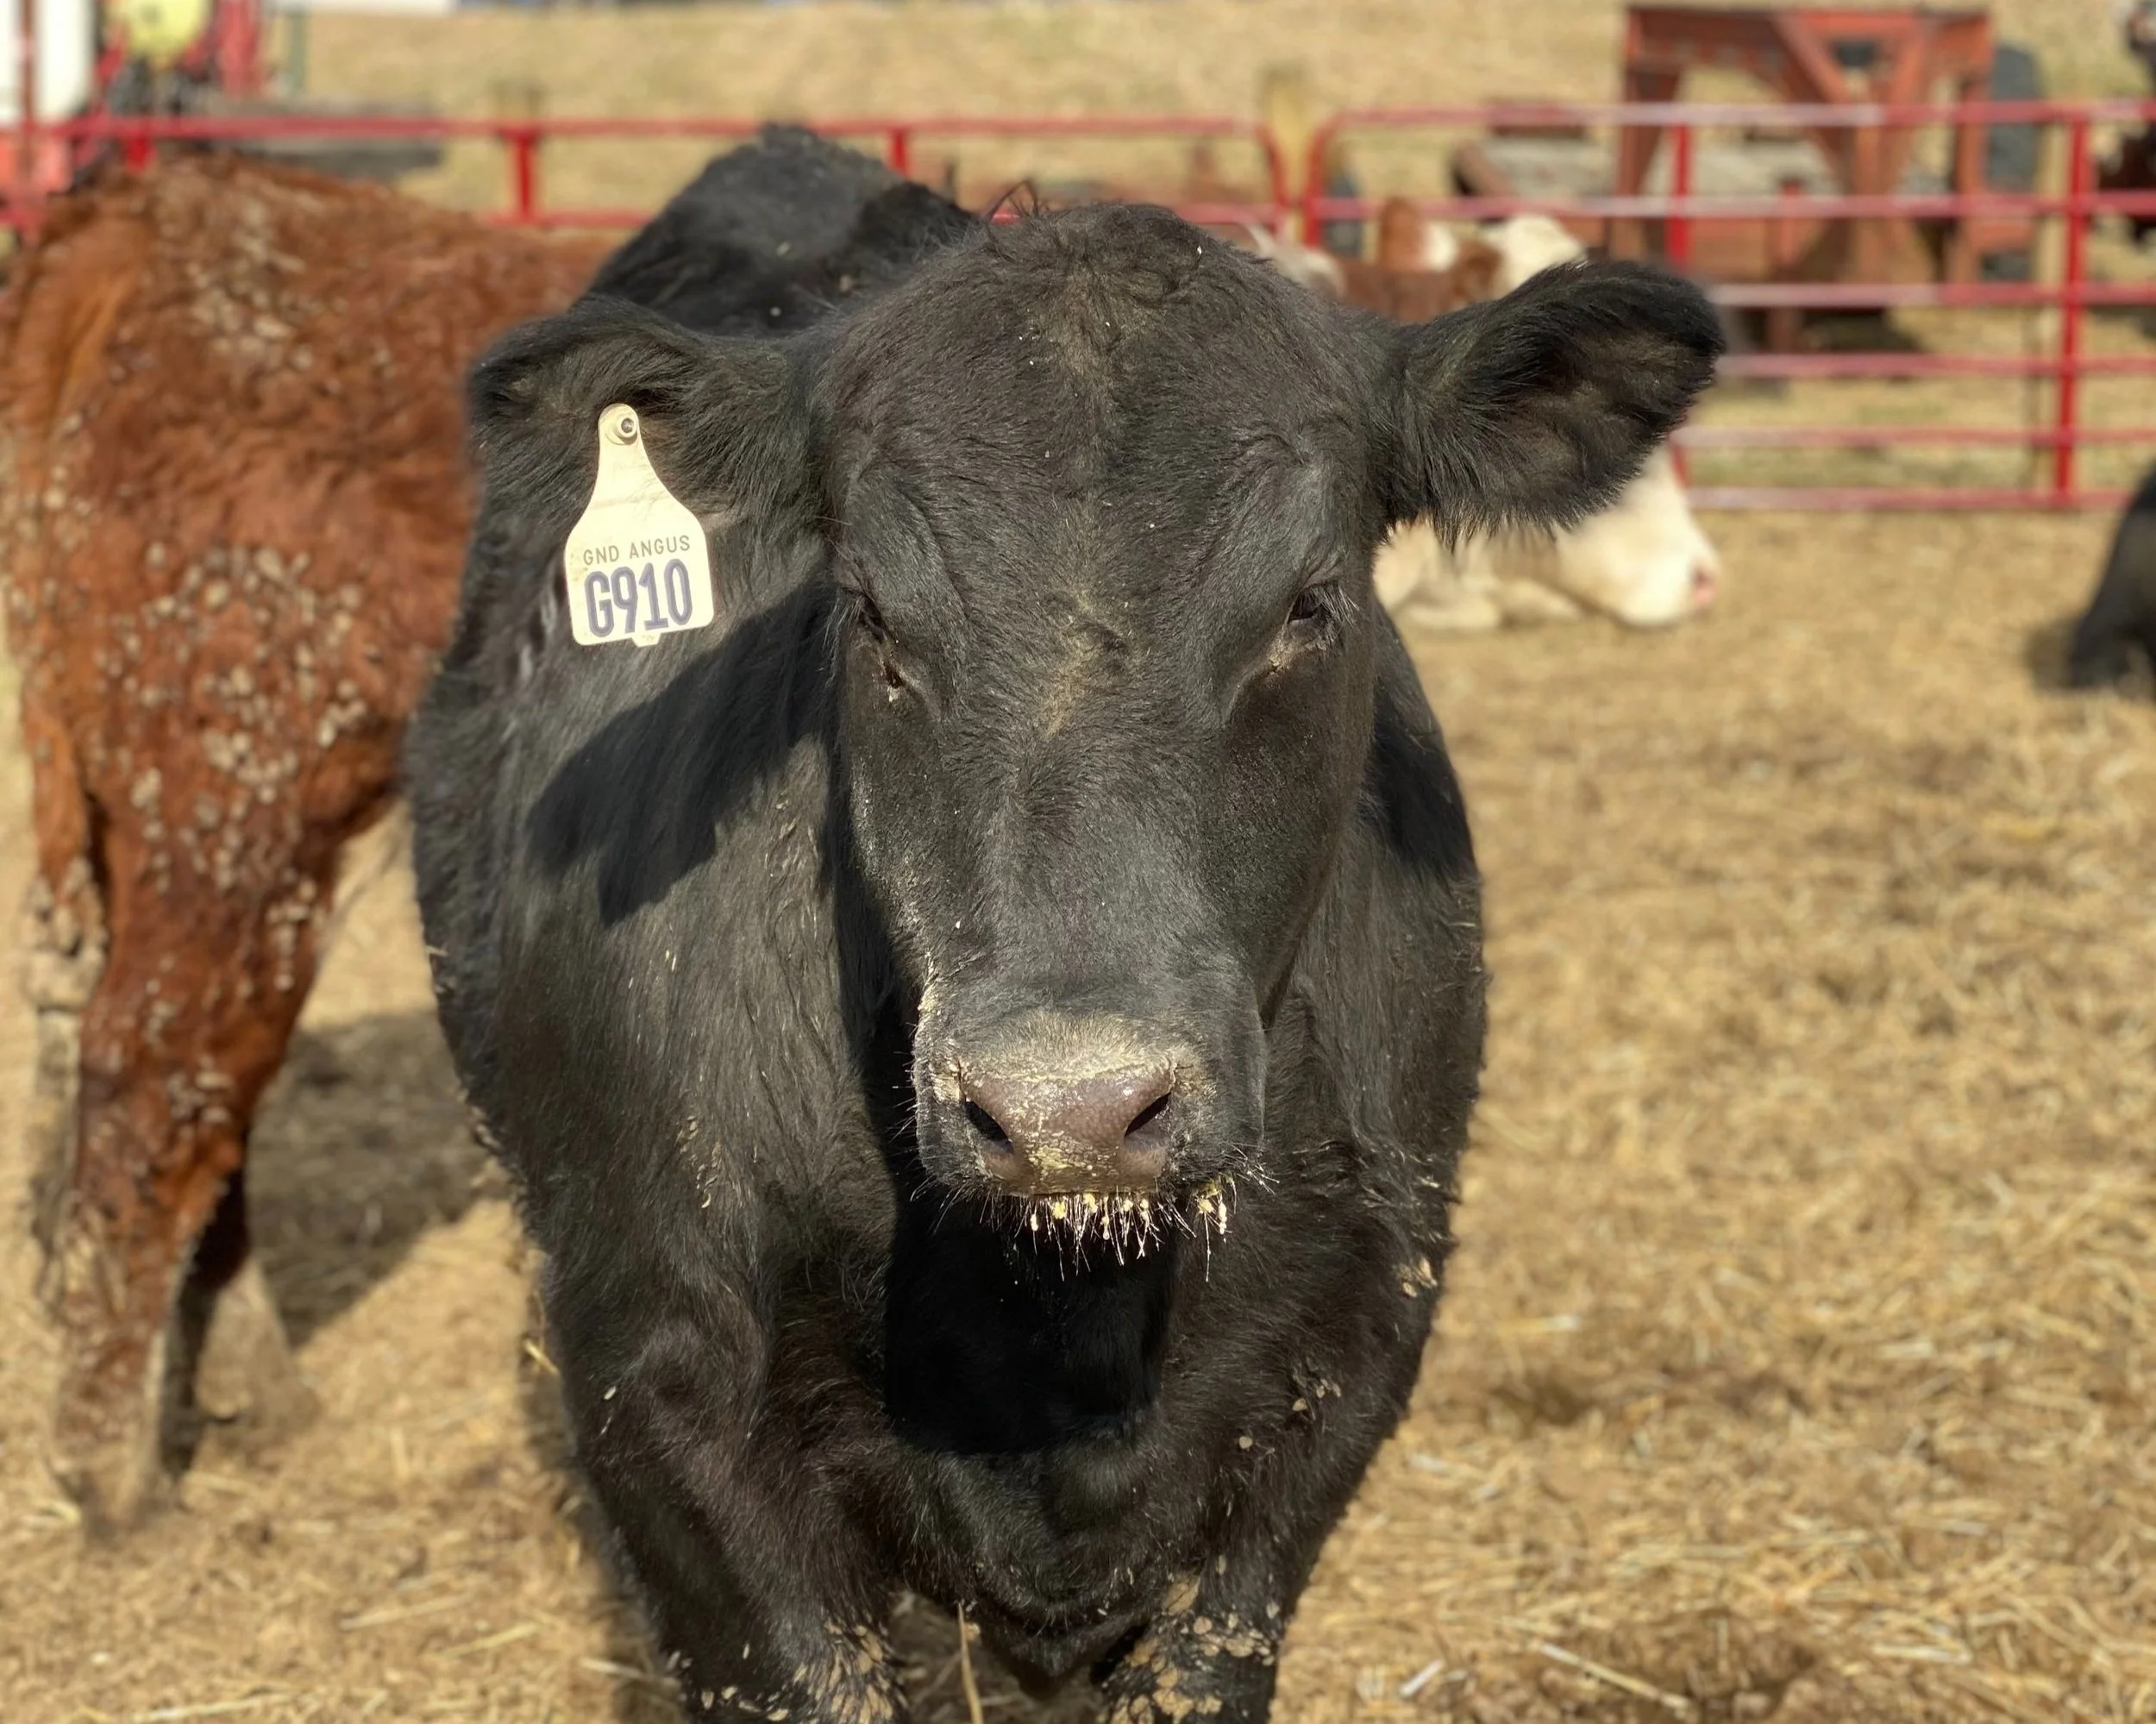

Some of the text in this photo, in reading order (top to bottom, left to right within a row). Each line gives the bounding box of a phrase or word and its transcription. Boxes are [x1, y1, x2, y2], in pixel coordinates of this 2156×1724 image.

[583, 535, 691, 566] GND ANGUS
[584, 559, 693, 637] G910
